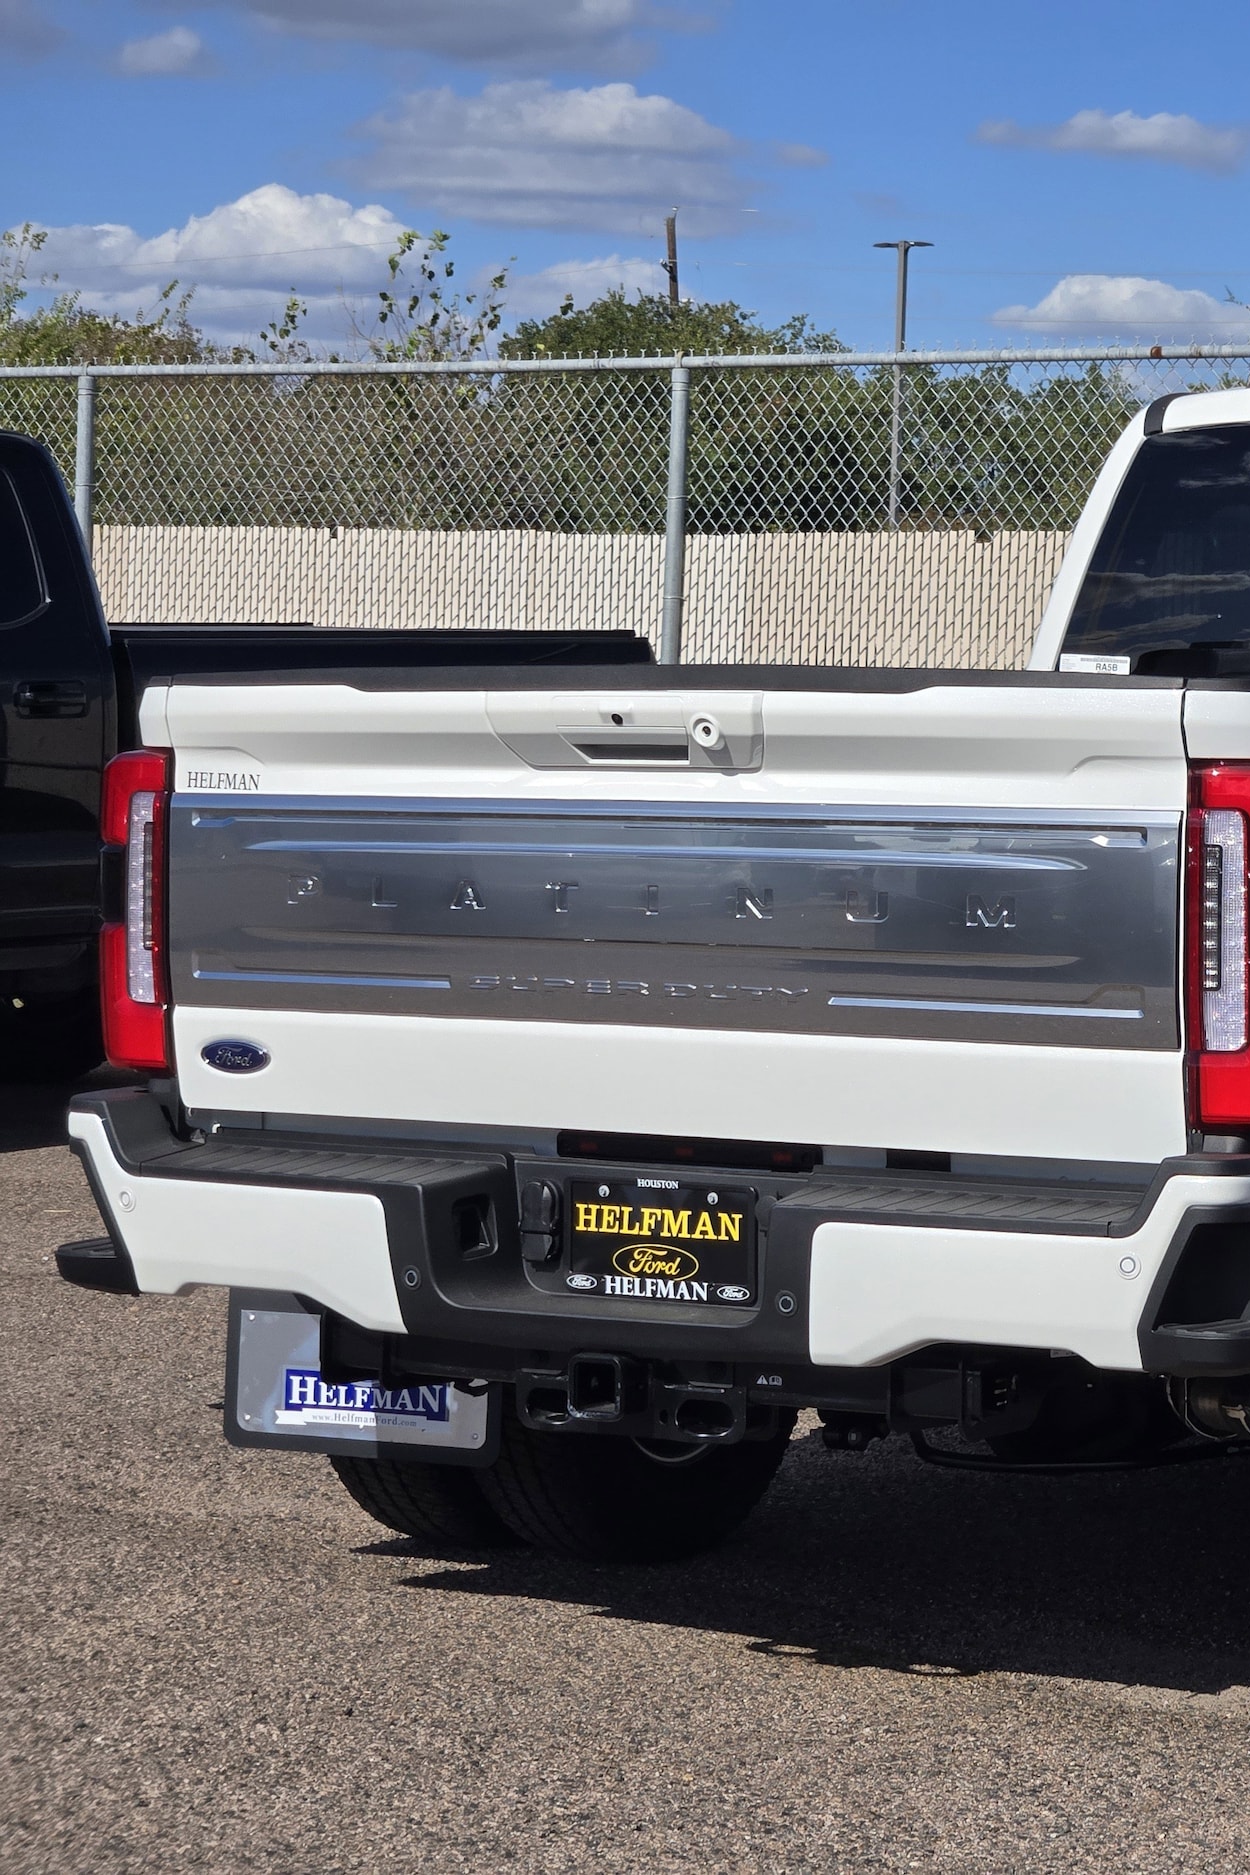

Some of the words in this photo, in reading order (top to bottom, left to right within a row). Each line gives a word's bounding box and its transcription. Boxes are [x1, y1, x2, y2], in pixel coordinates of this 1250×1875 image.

[187, 771, 260, 790] HELFMAN
[286, 874, 1017, 928] PLATINUM
[215, 1046, 253, 1067] Ford
[637, 1178, 679, 1190] HOUSTON
[575, 1203, 743, 1242] HELFMAN
[629, 1247, 682, 1276] Ford
[603, 1275, 709, 1302] HELFMAN
[288, 1375, 444, 1413] HELFMAN
[311, 1412, 417, 1428] www.HelfmanFord.com
